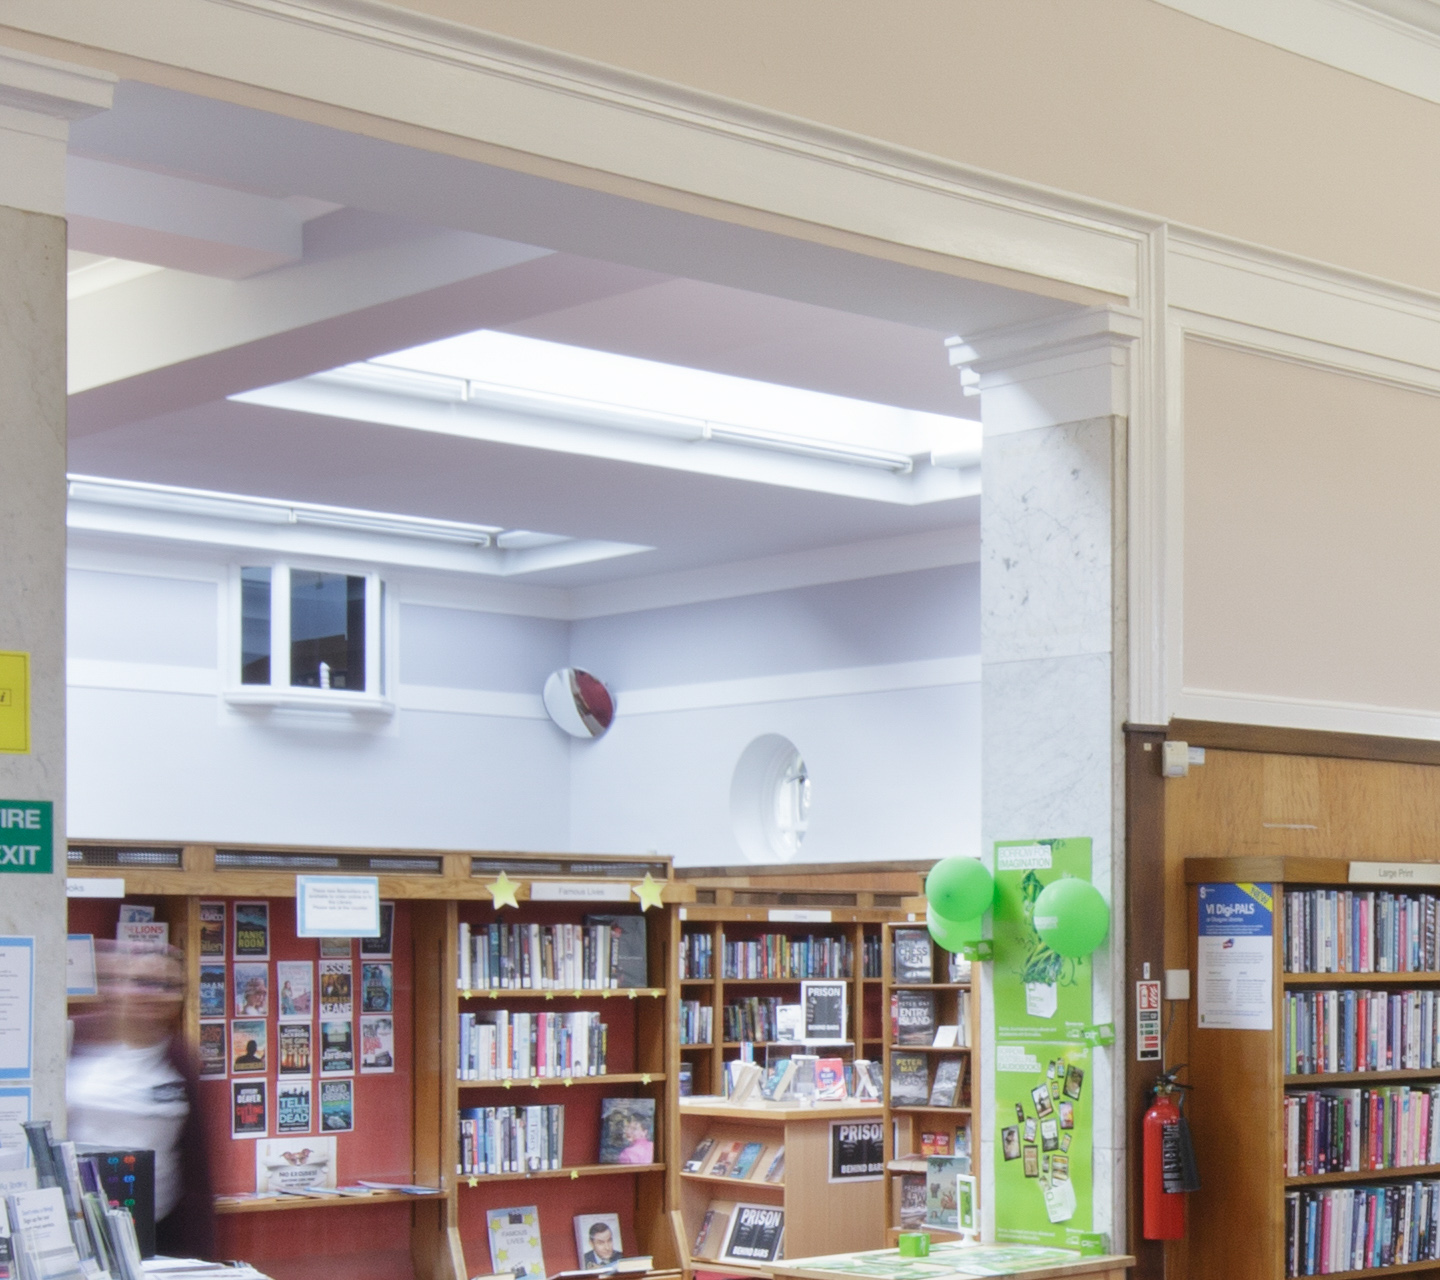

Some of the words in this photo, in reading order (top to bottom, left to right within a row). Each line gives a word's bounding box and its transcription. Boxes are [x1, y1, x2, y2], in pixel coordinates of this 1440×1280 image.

[1000, 857, 1050, 868] IMAGINATION
[1378, 868, 1396, 880] Large
[1398, 867, 1413, 877] Print
[558, 887, 585, 895] Famous
[587, 887, 605, 896] Lives
[1216, 903, 1255, 917] Digi-PALS
[238, 930, 264, 939] PANIC
[239, 938, 265, 948] ROOM
[900, 947, 928, 956] CHESS
[808, 987, 841, 997] PRISON
[322, 1002, 352, 1014] KEANE
[900, 1007, 929, 1016] ENTRY
[899, 1016, 931, 1026] ISLAND
[896, 1058, 922, 1066] PETER
[280, 1097, 308, 1108] TELL
[280, 1114, 308, 1123] DEAD
[741, 1208, 781, 1226] PRISON
[501, 1229, 528, 1238] FAMOUS
[506, 1237, 525, 1245] LIVES
